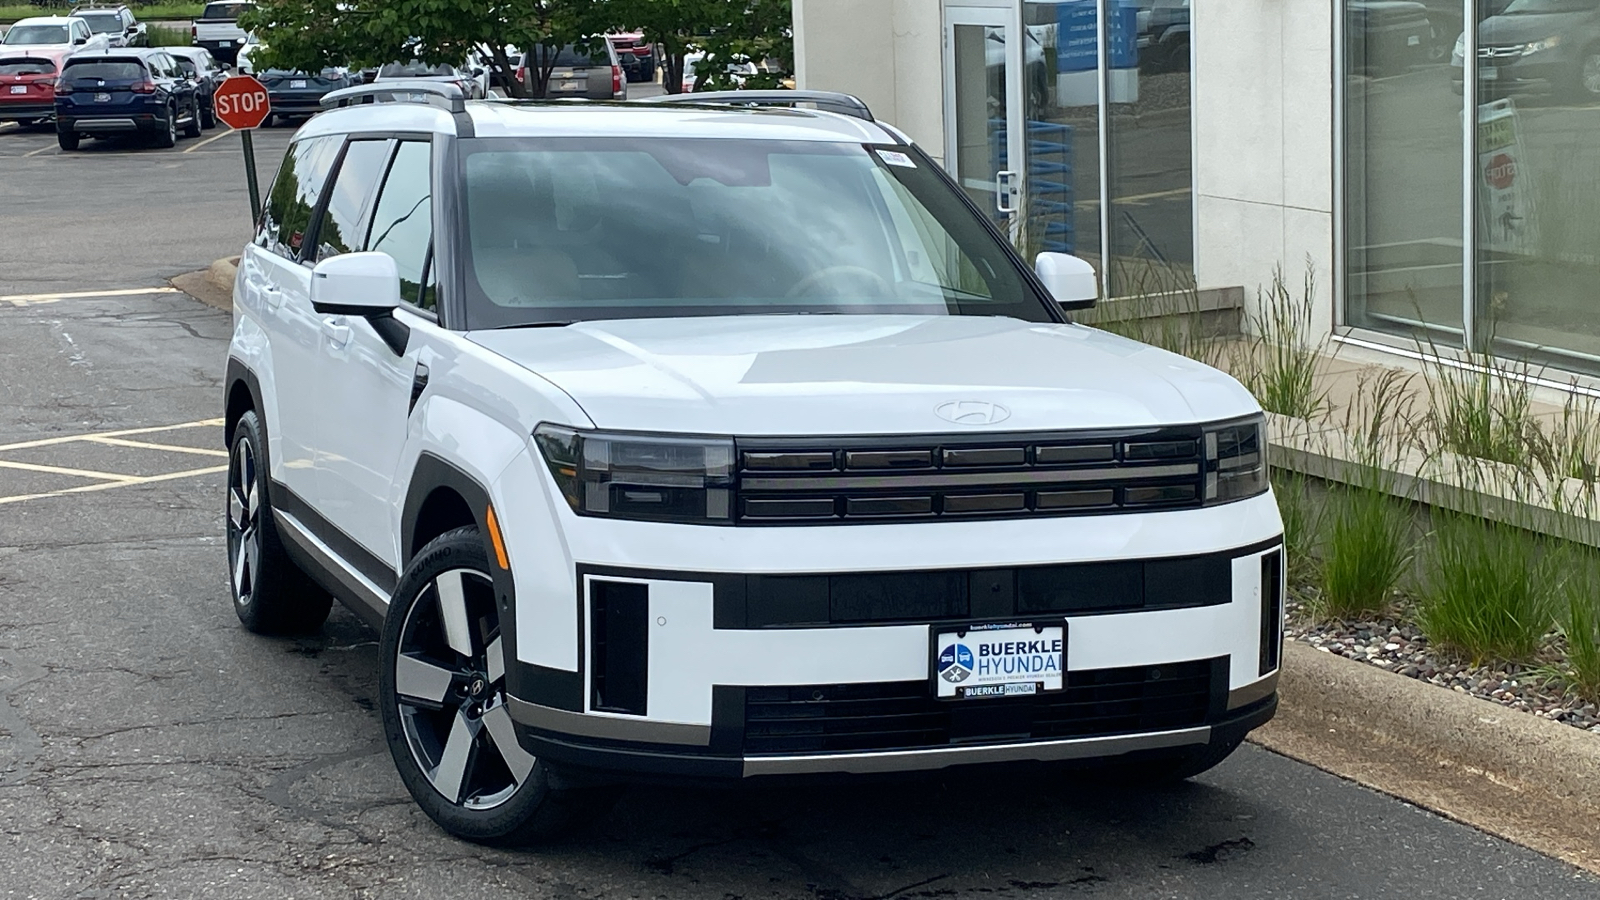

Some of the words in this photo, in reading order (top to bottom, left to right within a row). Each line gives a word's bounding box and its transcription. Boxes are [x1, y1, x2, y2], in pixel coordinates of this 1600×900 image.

[218, 91, 266, 115] STOP
[411, 546, 452, 580] KUMHO
[979, 639, 1062, 657] BUERKLE
[979, 653, 1062, 676] HYUNDAI
[965, 685, 1004, 697] BUERKLE
[1005, 682, 1035, 693] HYUNDAI
